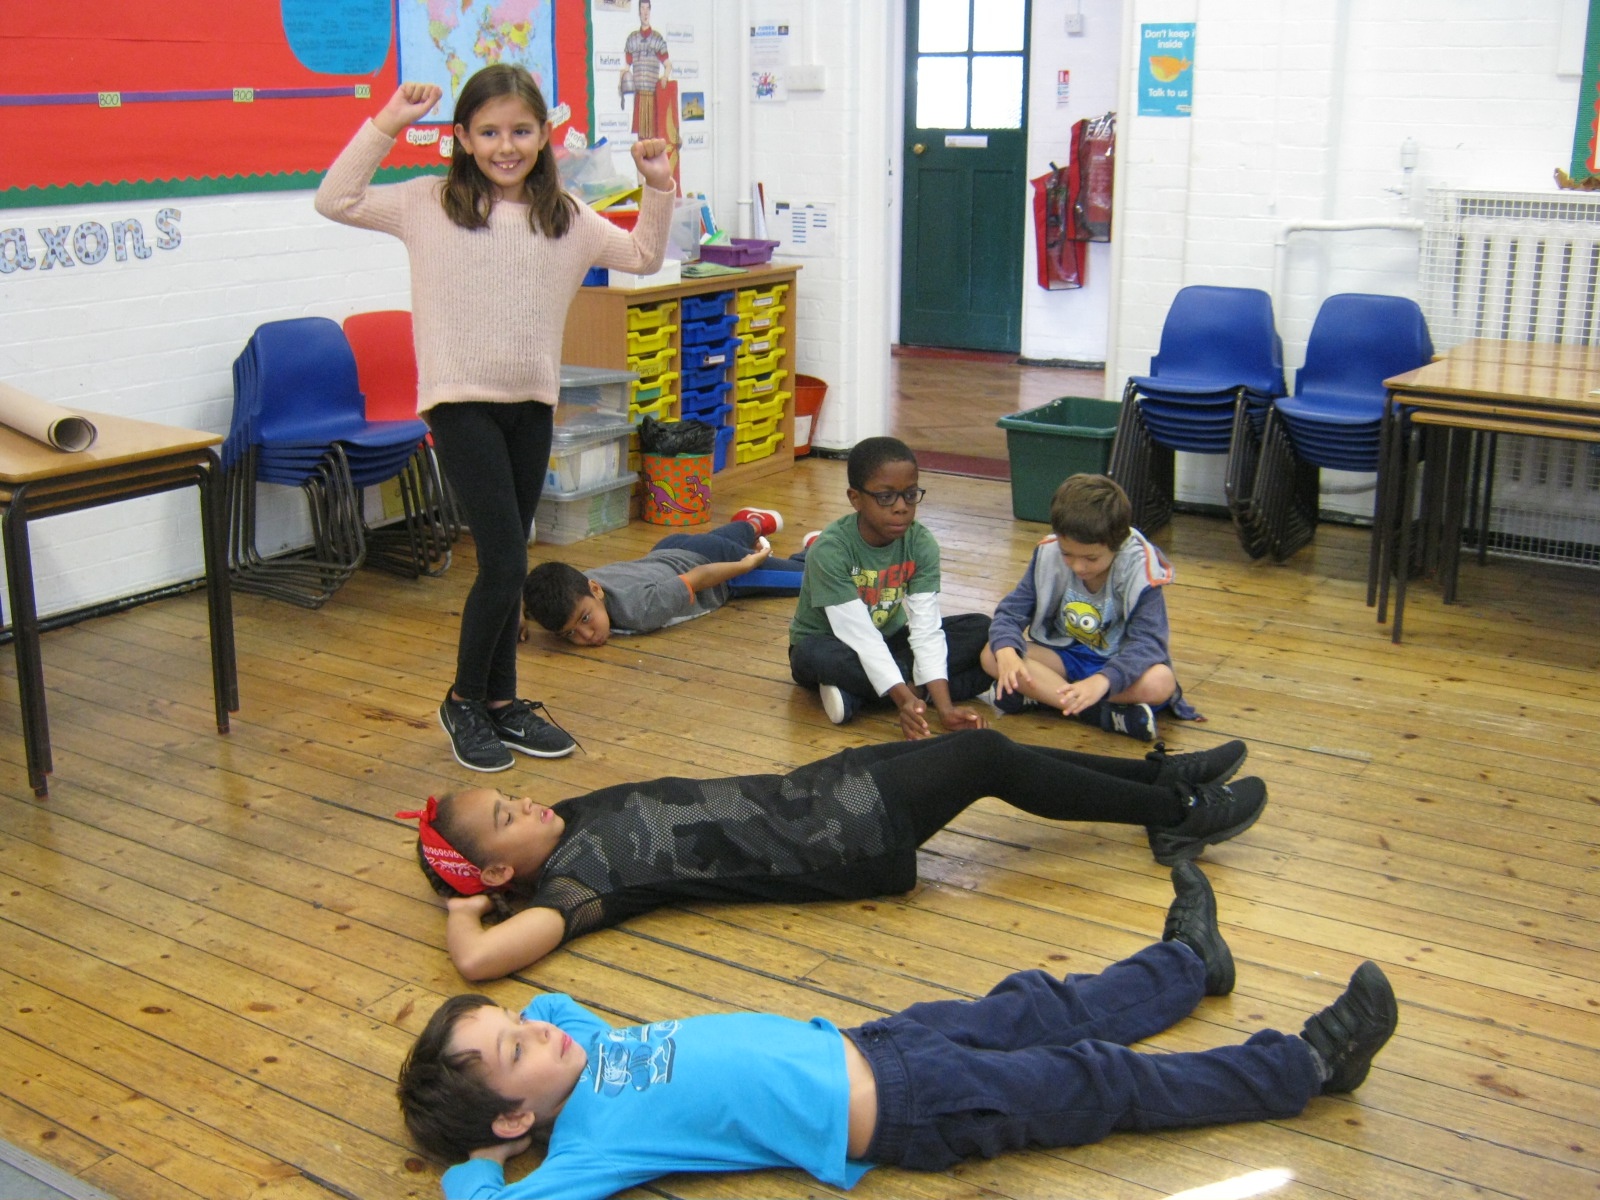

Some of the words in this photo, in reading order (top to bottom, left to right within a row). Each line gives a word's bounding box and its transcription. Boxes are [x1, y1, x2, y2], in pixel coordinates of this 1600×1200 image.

[1145, 29, 1166, 38] Don't
[1168, 29, 1190, 39] keep
[1157, 39, 1183, 49] inside
[600, 56, 621, 65] helmet
[233, 89, 253, 101] 900
[355, 85, 370, 97] 1000
[1148, 88, 1165, 97] Talk
[1167, 89, 1176, 97] to
[1177, 89, 1188, 97] us
[99, 93, 119, 106] 800
[688, 135, 704, 145] shield
[0, 208, 182, 274] axons
